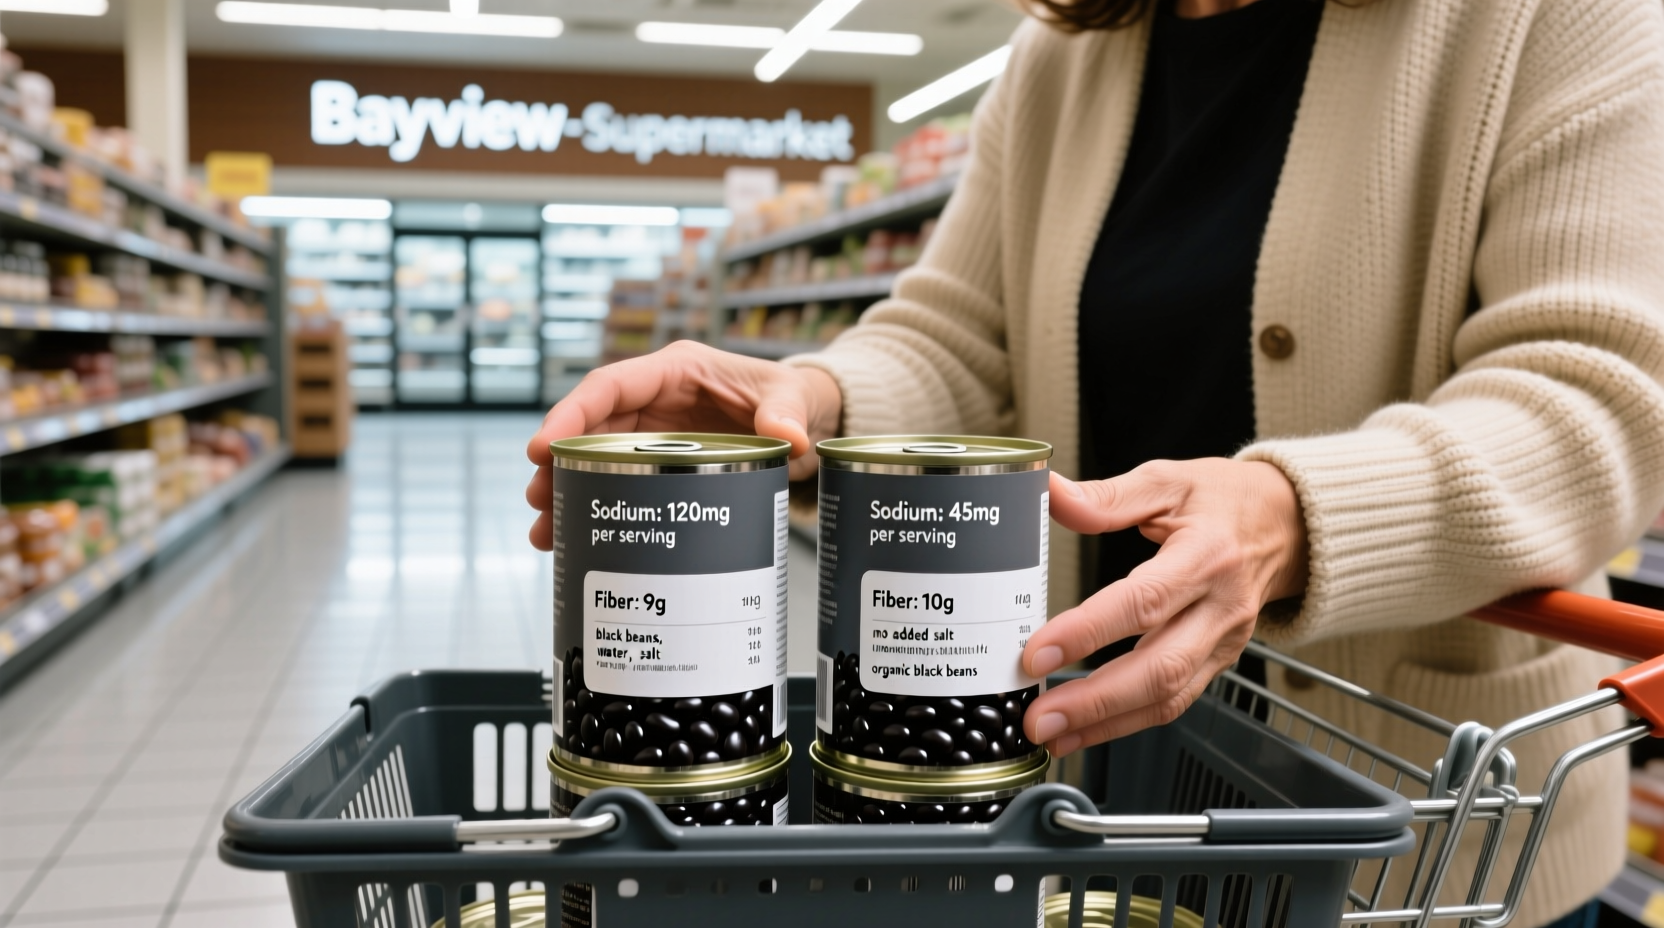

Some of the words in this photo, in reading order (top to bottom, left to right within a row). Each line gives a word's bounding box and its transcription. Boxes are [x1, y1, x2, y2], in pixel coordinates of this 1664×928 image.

[590, 499, 662, 522] Sodium:
[667, 501, 730, 526] 120mg
[870, 500, 944, 522] Sodium:
[948, 501, 1000, 525] 45mg
[592, 529, 615, 546] per
[619, 528, 676, 549] serving
[870, 529, 895, 546] per
[898, 528, 956, 549] serving
[594, 590, 639, 610] Fiber:
[643, 593, 666, 616] 9g
[872, 589, 918, 609] Fiber:
[921, 593, 954, 615] 10g
[596, 627, 623, 642] black
[625, 628, 663, 645] beans,
[892, 626, 929, 641] added
[933, 627, 954, 641] salt
[871, 663, 911, 679] organic
[914, 664, 943, 677] black
[946, 664, 978, 677] beans
